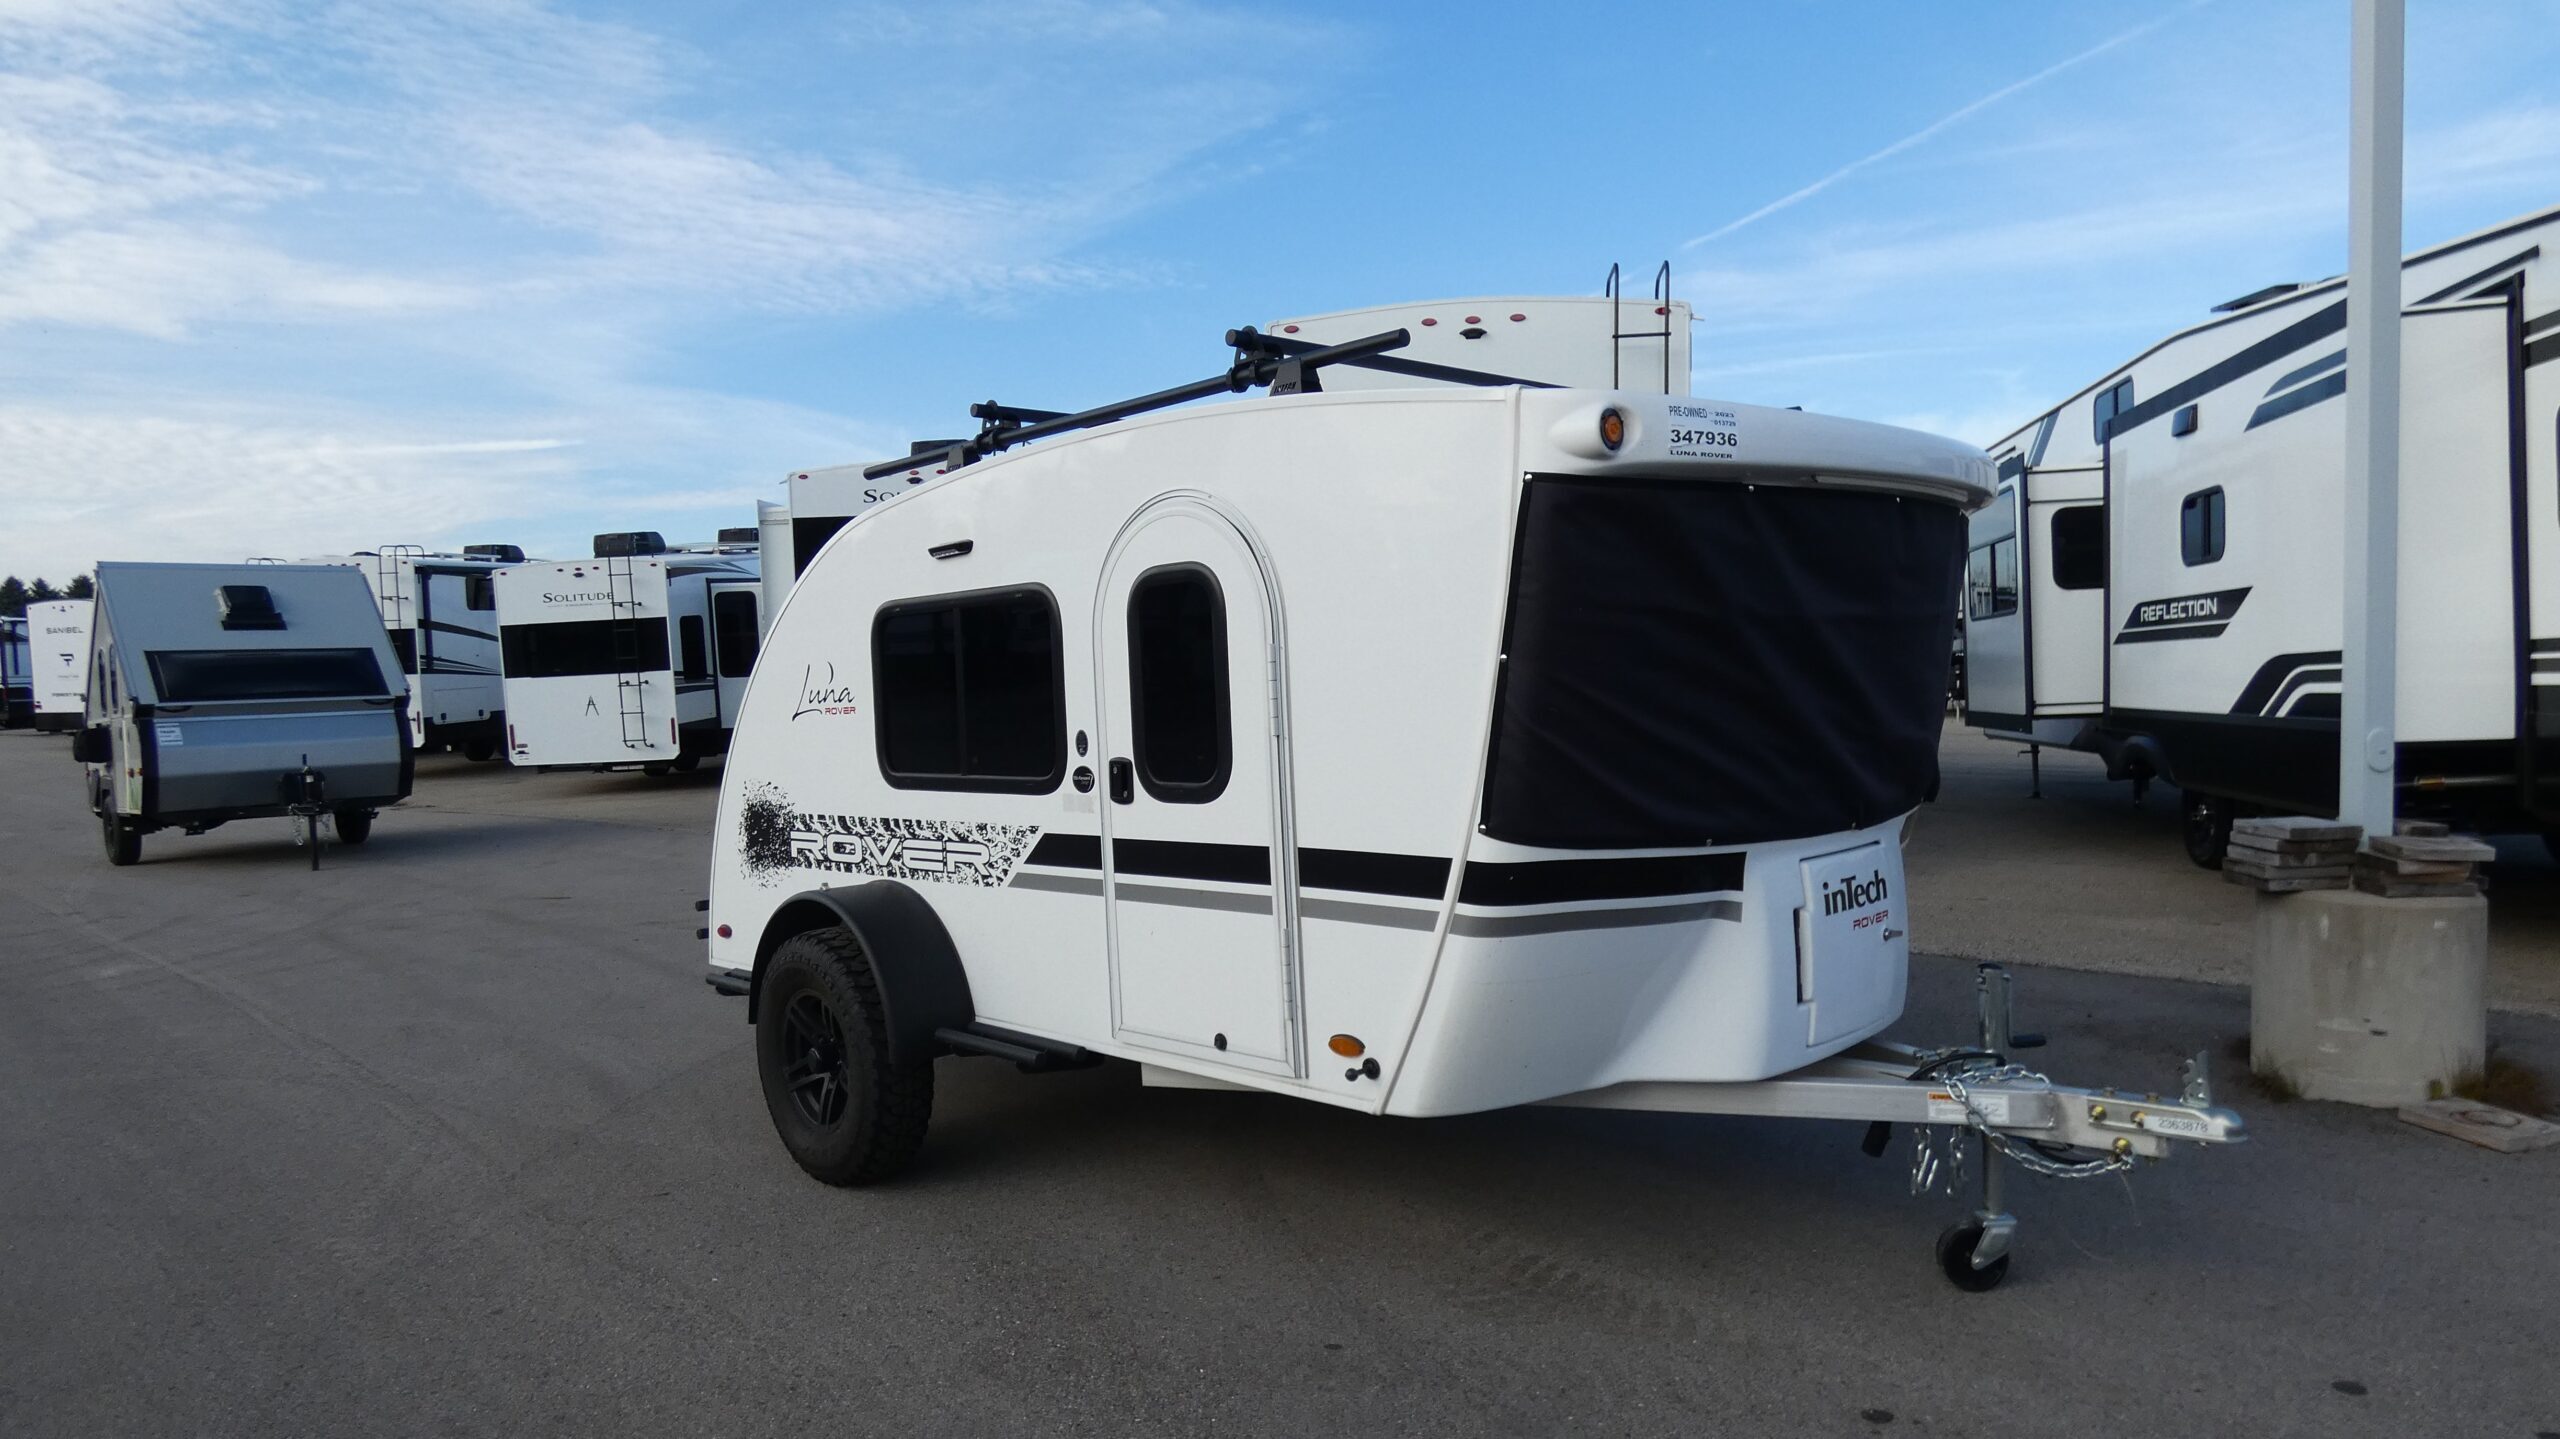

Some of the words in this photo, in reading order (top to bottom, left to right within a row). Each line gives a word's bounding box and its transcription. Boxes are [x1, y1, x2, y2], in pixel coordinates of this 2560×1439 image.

[1668, 405, 1708, 419] PRE-OWNED
[1670, 429, 1738, 447] 347936
[2140, 597, 2218, 623] REFLECTION
[46, 626, 84, 635] SANIBEL
[792, 664, 855, 722] Luna
[824, 706, 856, 715] ROVER
[789, 830, 993, 877] ROVER
[1822, 869, 1888, 917] inTech
[1852, 909, 1889, 931] ROVER
